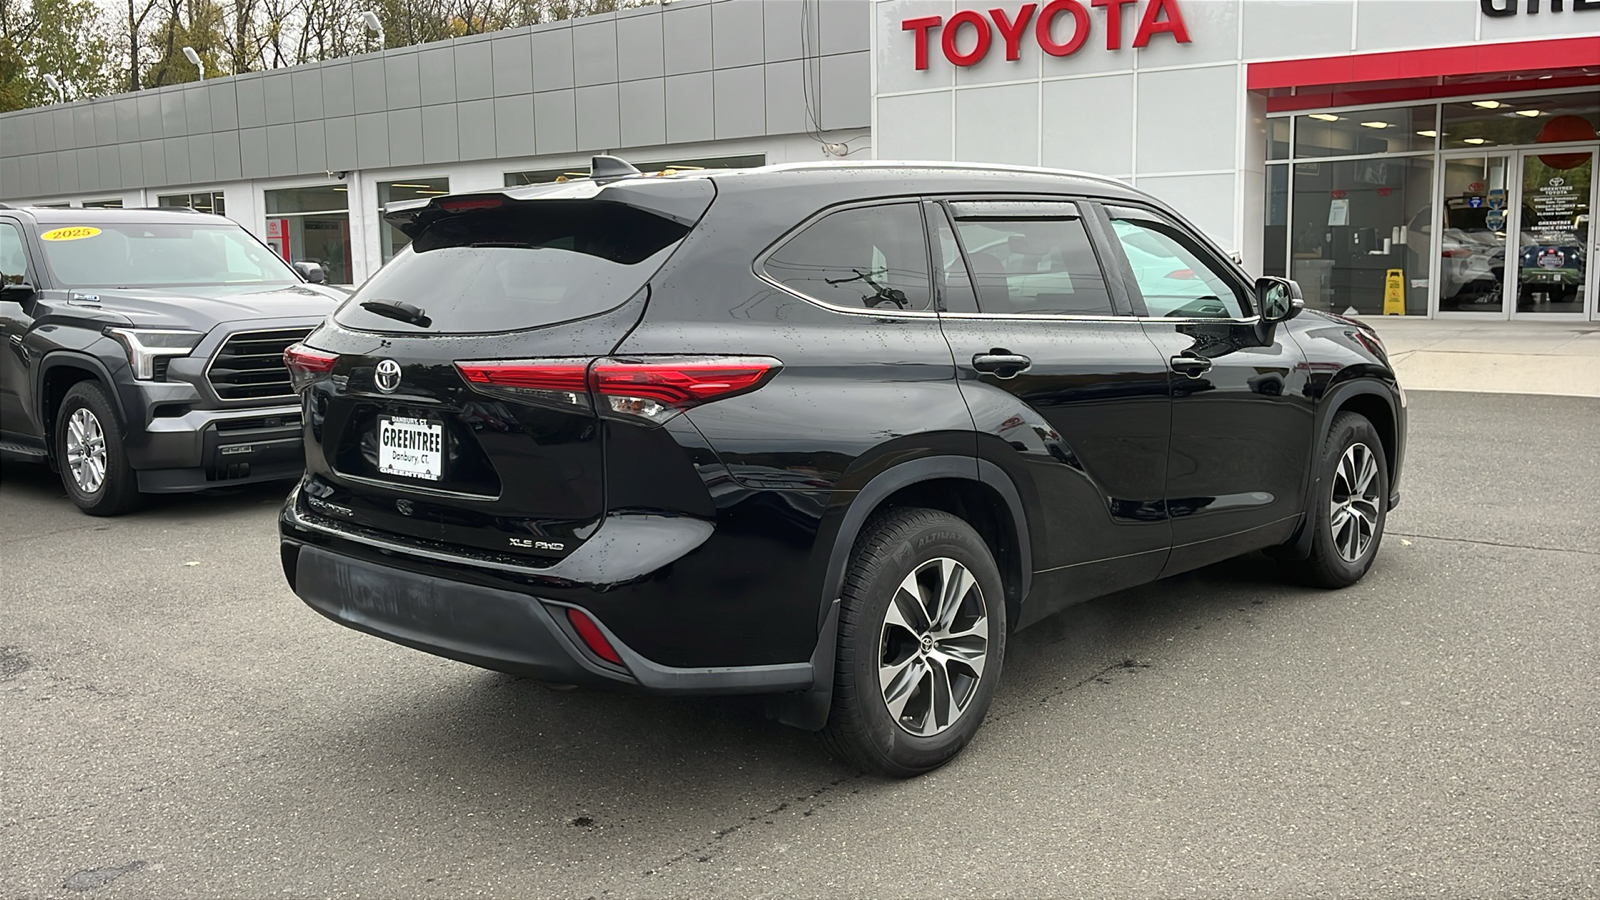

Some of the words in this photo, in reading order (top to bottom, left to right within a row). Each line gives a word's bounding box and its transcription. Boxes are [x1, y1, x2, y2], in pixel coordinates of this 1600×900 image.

[902, 0, 1192, 70] TOYOTA
[53, 228, 91, 239] 2025
[383, 427, 440, 452] GREENTREE
